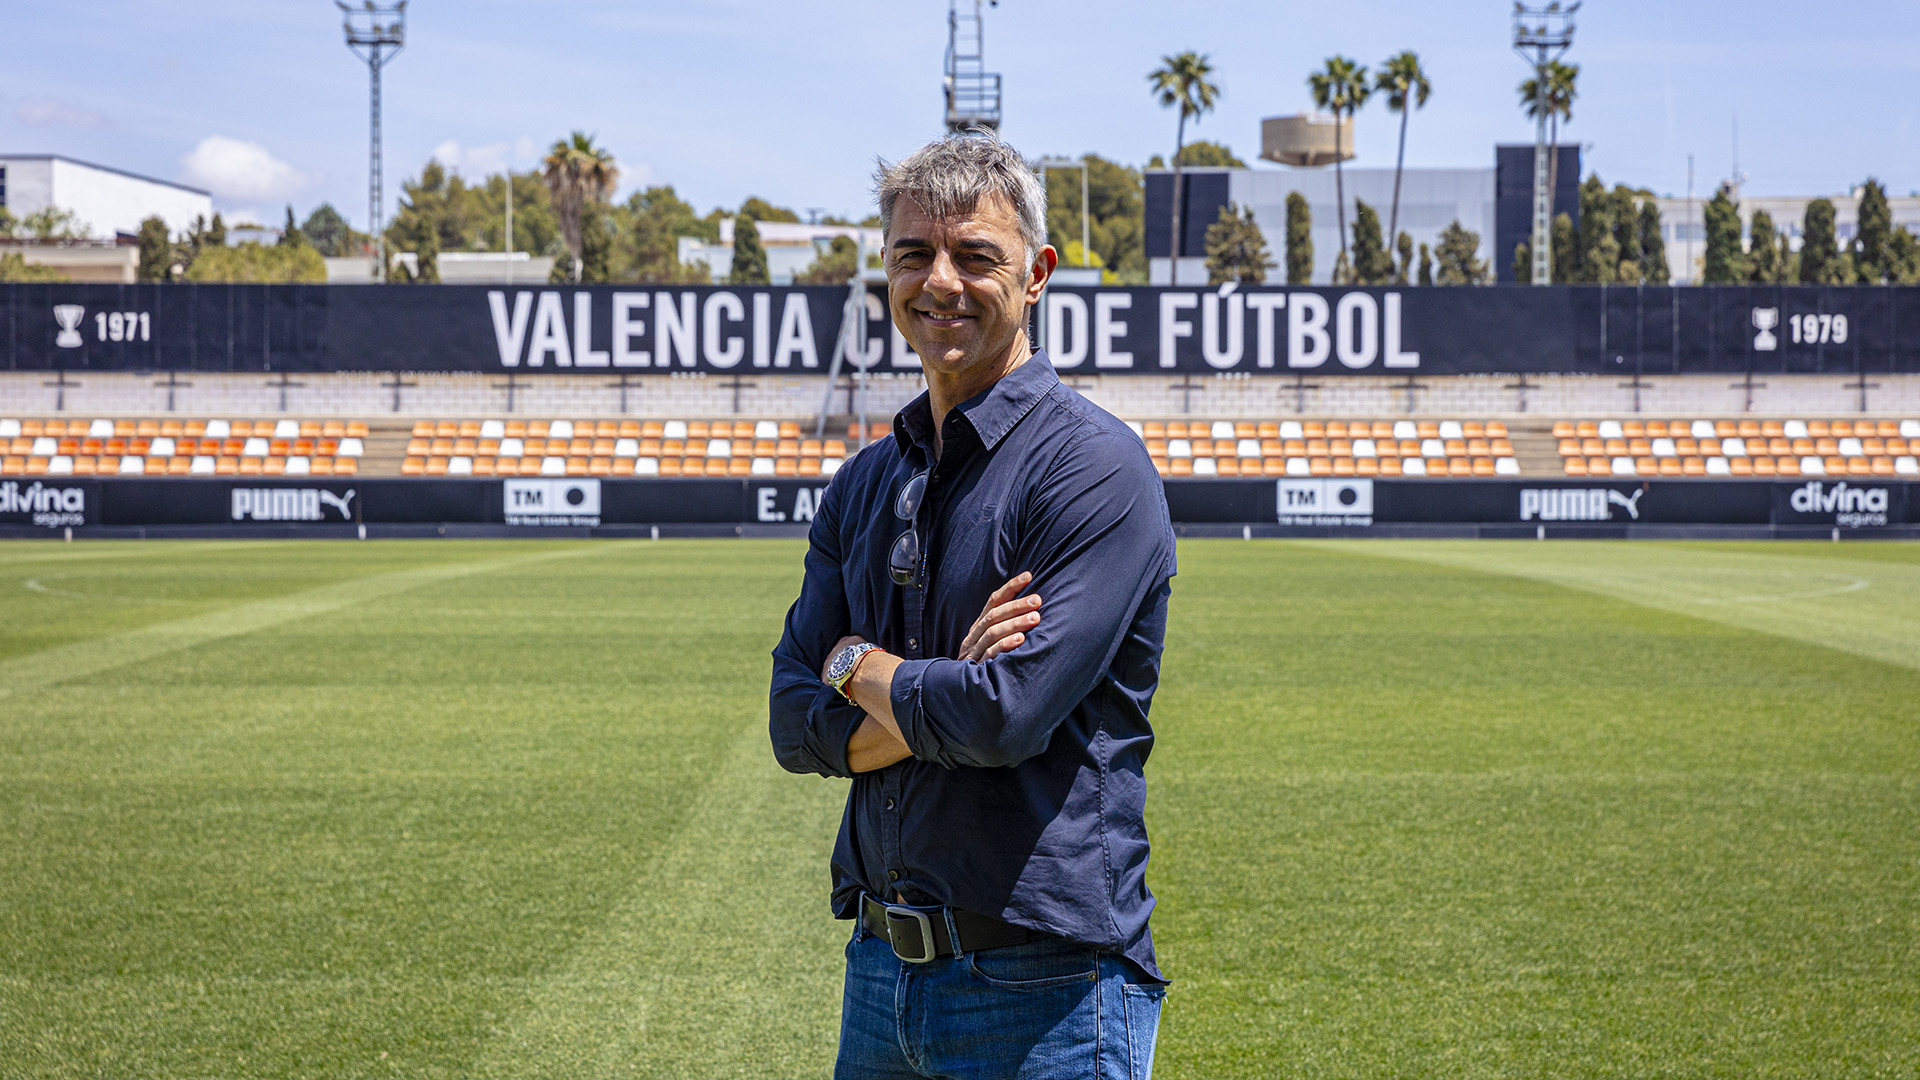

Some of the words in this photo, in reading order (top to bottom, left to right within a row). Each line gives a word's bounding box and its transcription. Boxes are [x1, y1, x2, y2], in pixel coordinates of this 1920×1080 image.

[95, 311, 150, 342] 1971
[487, 290, 819, 369] VALENCIA
[843, 291, 922, 369] CL
[1047, 292, 1134, 368] DE
[1159, 281, 1420, 370] FÚTBOL
[1790, 313, 1849, 344] 1979
[231, 488, 321, 520] PUMA
[513, 489, 543, 506] TM
[757, 487, 786, 522] E.
[1286, 489, 1316, 506] TM
[1520, 488, 1608, 520] PUMA
[1790, 481, 1888, 513] divina
